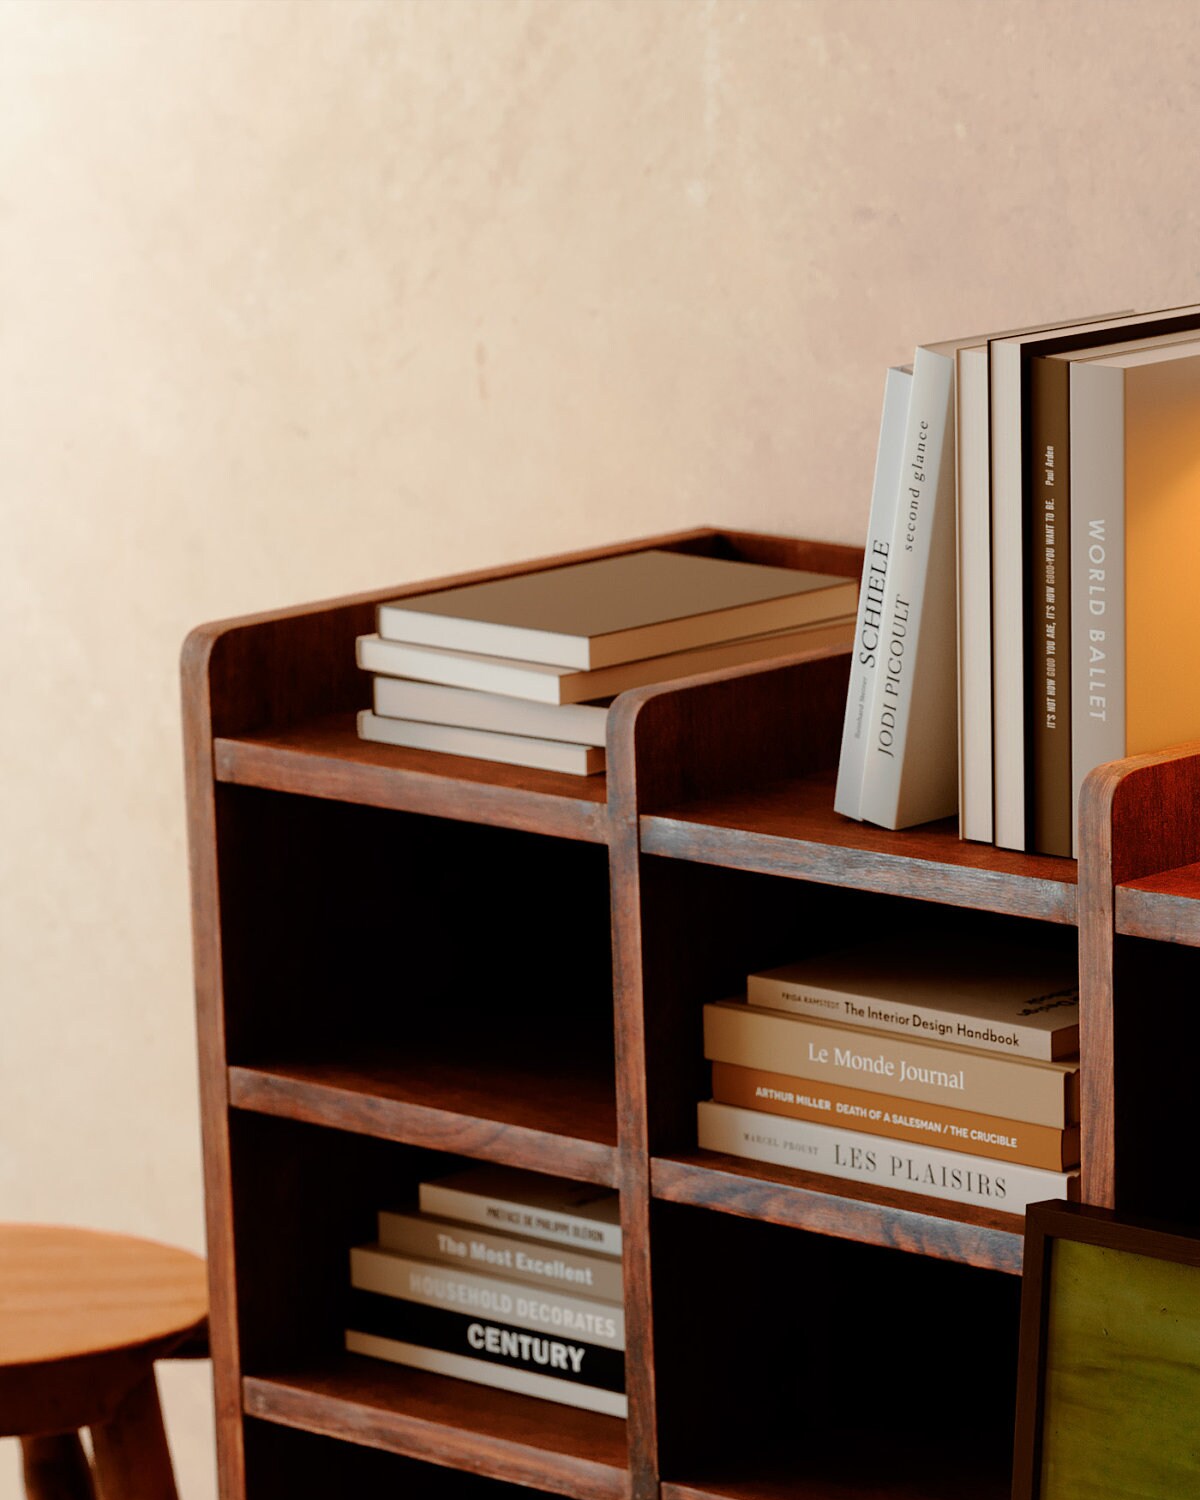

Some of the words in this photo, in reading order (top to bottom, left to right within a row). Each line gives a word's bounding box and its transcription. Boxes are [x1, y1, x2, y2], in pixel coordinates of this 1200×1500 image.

[911, 420, 929, 482] glance
[1045, 445, 1054, 467] Arden
[1045, 469, 1054, 486] Paul
[905, 487, 921, 551] second
[1045, 512, 1055, 522] TO
[1045, 524, 1055, 545] WANT
[1088, 519, 1106, 616] WORLD
[859, 539, 890, 669] SCHIELE
[1046, 586, 1055, 603] HOW
[885, 593, 910, 697] PICOULT
[1046, 640, 1056, 655] YOU
[1046, 678, 1056, 696] HOW
[1089, 629, 1106, 721] BALLET
[877, 702, 897, 758] JODI
[1046, 697, 1056, 713] NOT
[1046, 713, 1056, 729] IT'S
[844, 1001, 865, 1017] The
[868, 1006, 910, 1025] Interior
[912, 1014, 953, 1035] Design
[957, 1023, 1020, 1047] Handbook
[808, 1042, 828, 1064] Le
[834, 1047, 895, 1076] Monde
[900, 1060, 965, 1091] Journal
[755, 1087, 794, 1103] ARTHUR
[796, 1094, 831, 1110] MILLER
[836, 1103, 868, 1118] DEATH
[869, 1109, 882, 1120] OF
[883, 1112, 891, 1123] A
[891, 1113, 942, 1133] SALESMAN
[950, 1125, 969, 1138] THE
[970, 1129, 1018, 1148] CRUCIBLE
[834, 1144, 877, 1172] LES
[890, 1155, 1007, 1199] PLAISIRS
[437, 1233, 467, 1257] The
[470, 1241, 512, 1268] Most
[515, 1252, 593, 1285] Excellent
[410, 1271, 513, 1315] HOUSEHOLD
[516, 1297, 616, 1338] DECORATES
[467, 1323, 585, 1373] CENTURY
